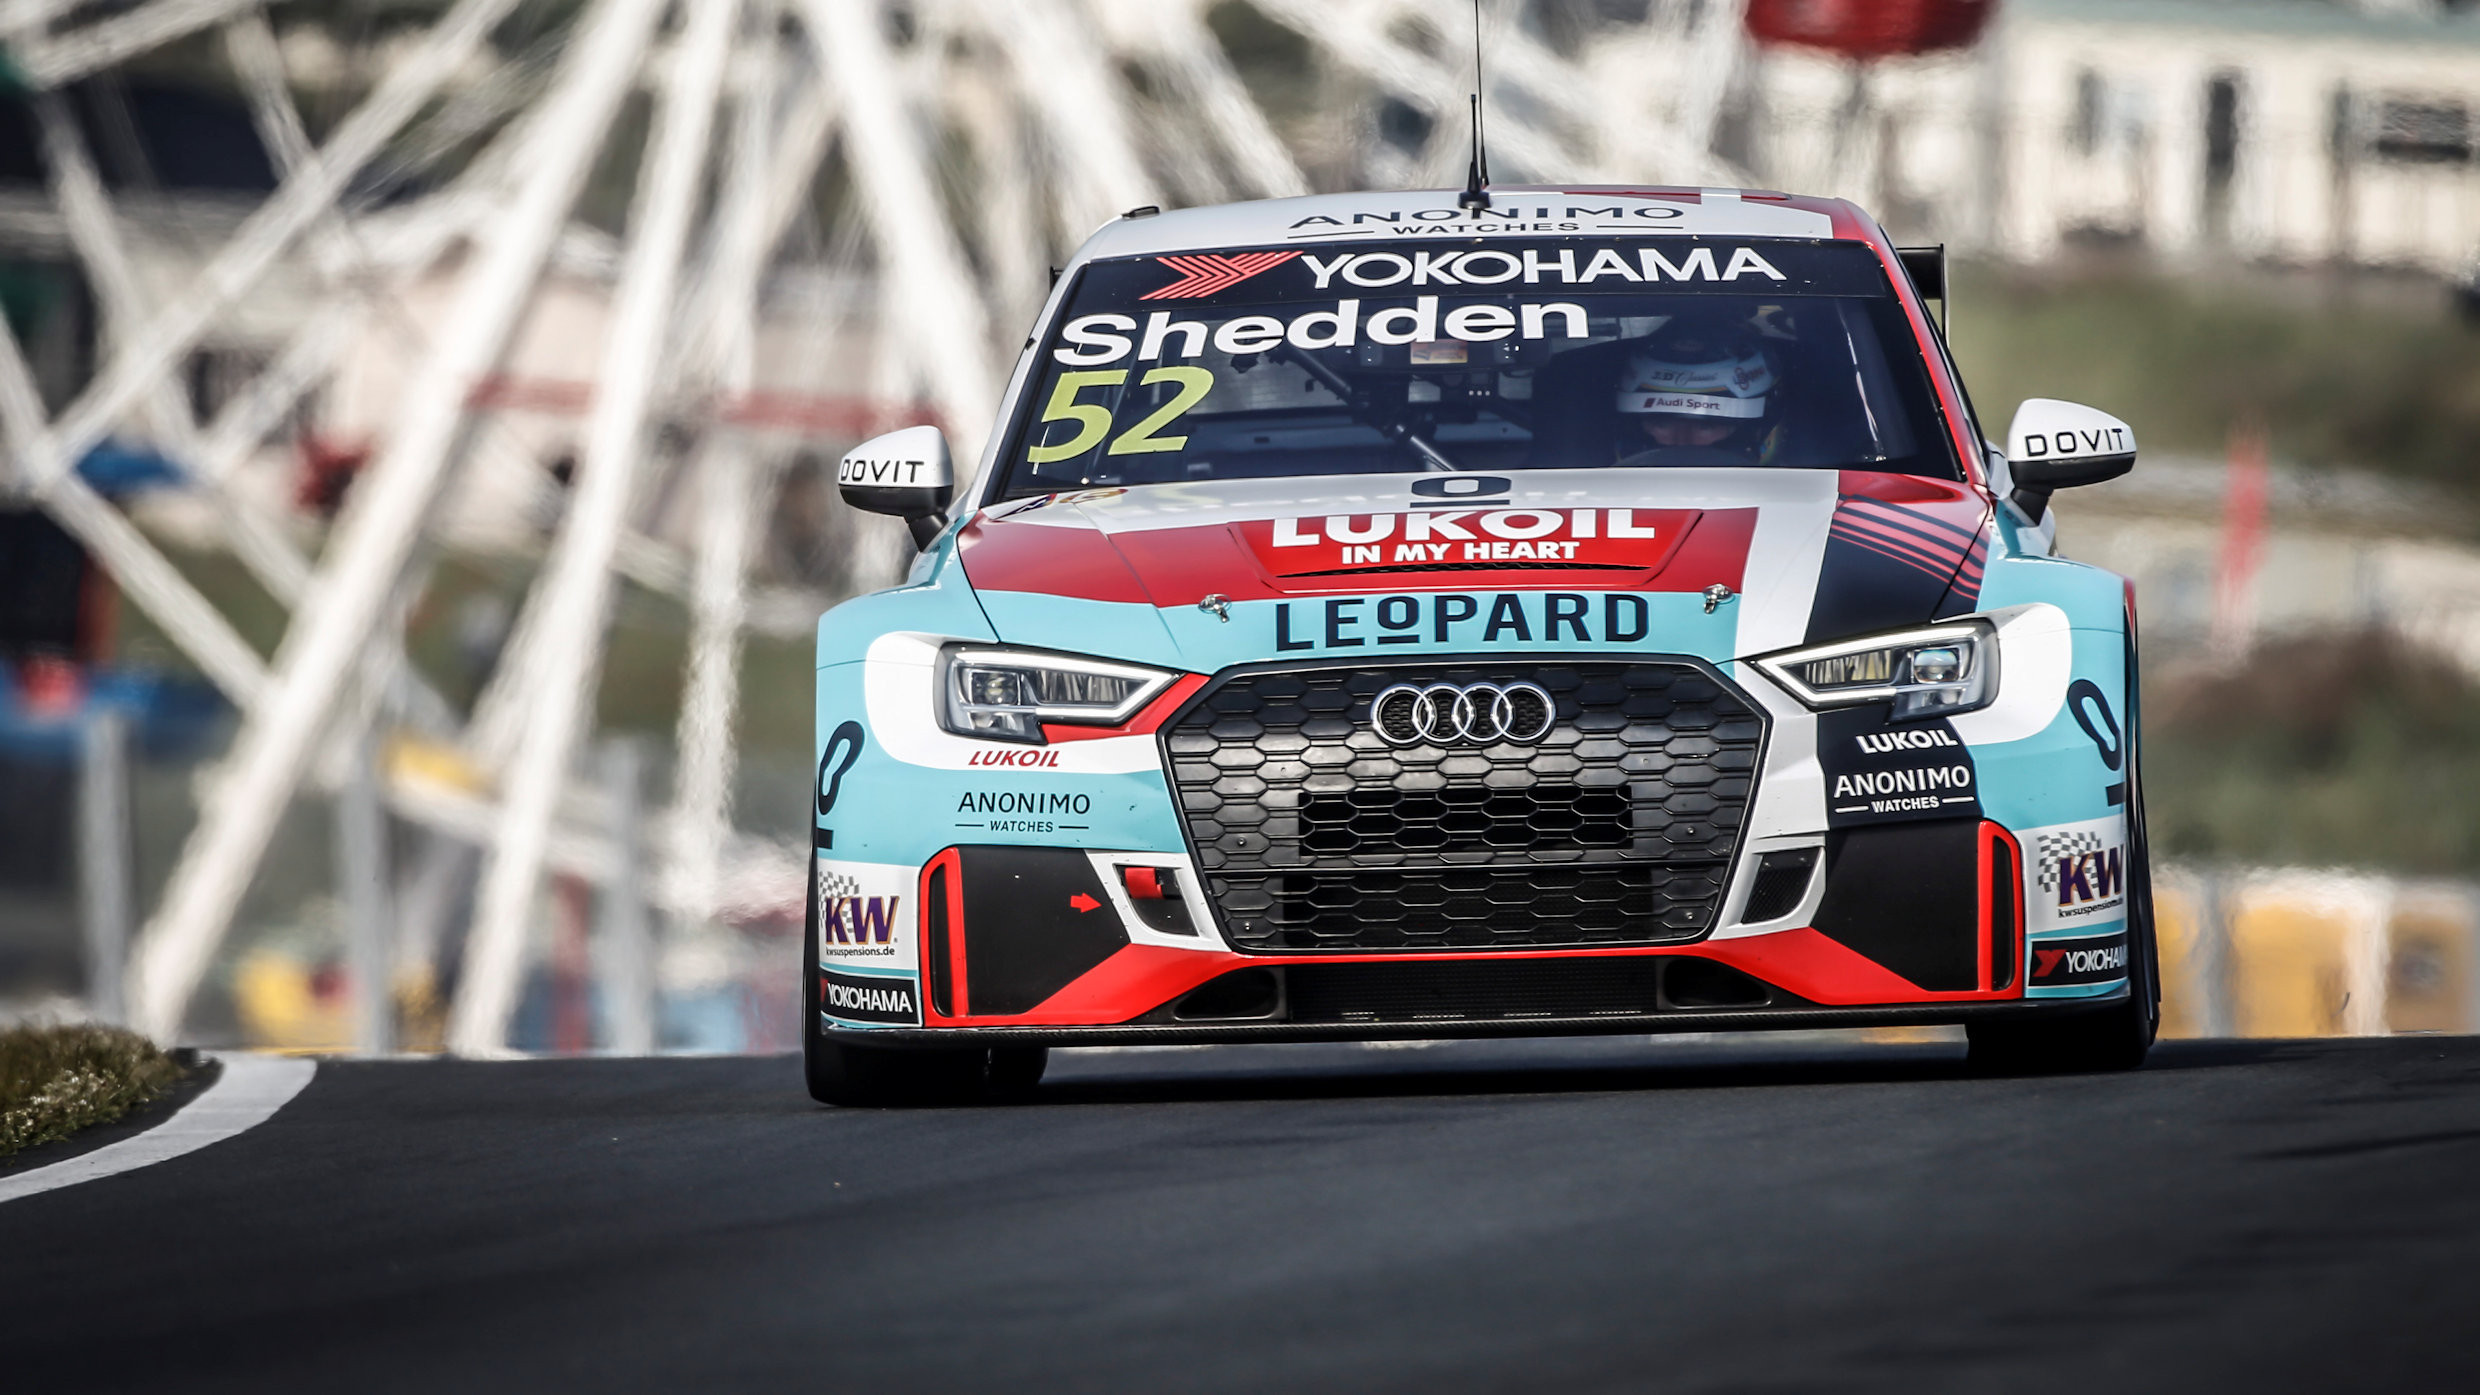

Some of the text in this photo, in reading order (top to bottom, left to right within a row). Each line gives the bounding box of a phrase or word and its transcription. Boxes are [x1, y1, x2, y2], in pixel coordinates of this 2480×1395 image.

[1289, 206, 1685, 229] ANONIMO
[1391, 221, 1581, 235] WATCHES
[1301, 246, 1786, 290] YOKOHAMA
[1053, 298, 1588, 366] Shedden
[1027, 366, 1214, 463] 52
[1656, 397, 1721, 411] Audi Sport
[2024, 427, 2123, 457] DOVIT
[840, 458, 925, 483] DOVIT
[1272, 508, 1656, 547] LUKOIL
[1342, 541, 1580, 564] IN MY HEART
[1275, 592, 1650, 652] LEOPARD
[1855, 728, 1958, 755] LUKOIL
[967, 749, 1061, 768] LUKOIL
[1833, 764, 1971, 799] ANONIMO
[957, 791, 1091, 815] ANONIMO
[1871, 795, 1940, 814] WATCHES
[989, 820, 1054, 833] WATCHES
[2058, 843, 2125, 907] KW
[825, 895, 900, 945] KW
[825, 945, 895, 958] kwsuspensions.de
[826, 981, 914, 1014] YOKOHAMA
